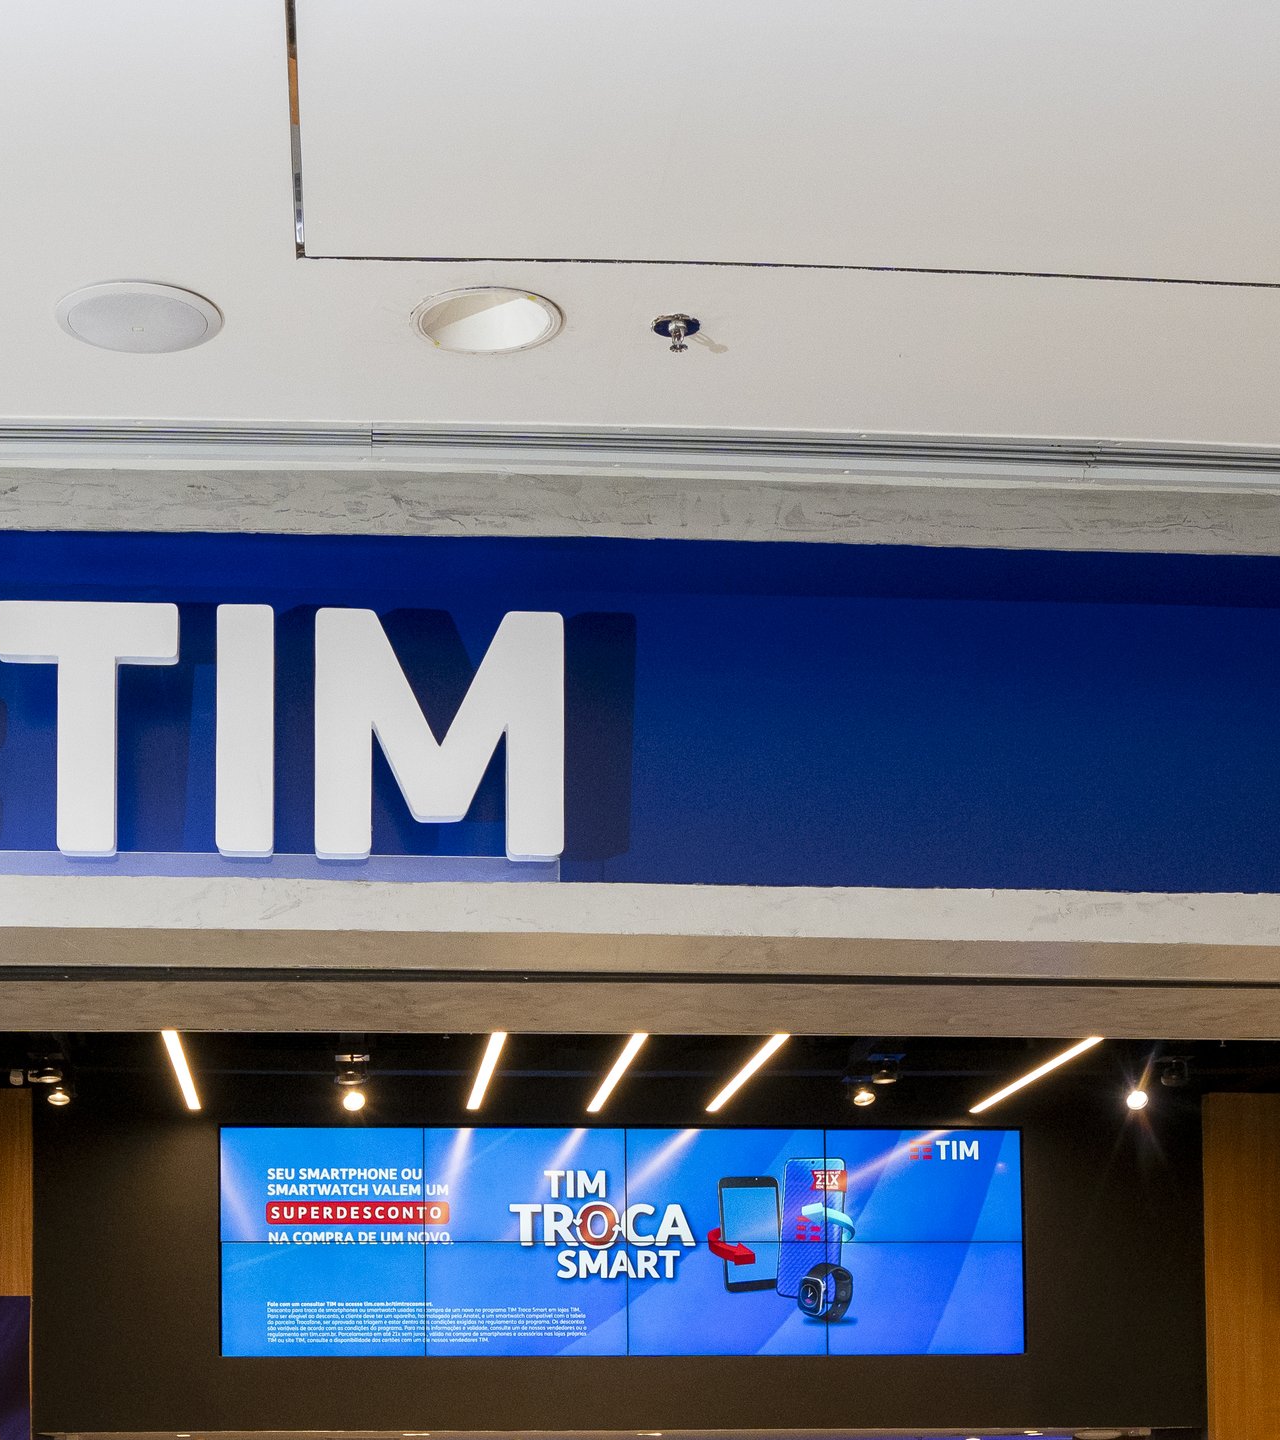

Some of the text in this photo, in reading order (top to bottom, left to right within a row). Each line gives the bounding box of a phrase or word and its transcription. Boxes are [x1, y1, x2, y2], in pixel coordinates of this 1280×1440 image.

[936, 1140, 979, 1160] TIM
[268, 1168, 422, 1180] SEU SMARTPHONE OU
[268, 1182, 451, 1197] SMARTWATCH VALEM UM
[544, 1170, 606, 1198] TIM
[271, 1206, 442, 1219] SUPERDESCONTO
[509, 1201, 697, 1249] TROCA
[269, 1230, 453, 1244] NA COMPRA DE UM NOVO.
[557, 1250, 681, 1279] SMART
